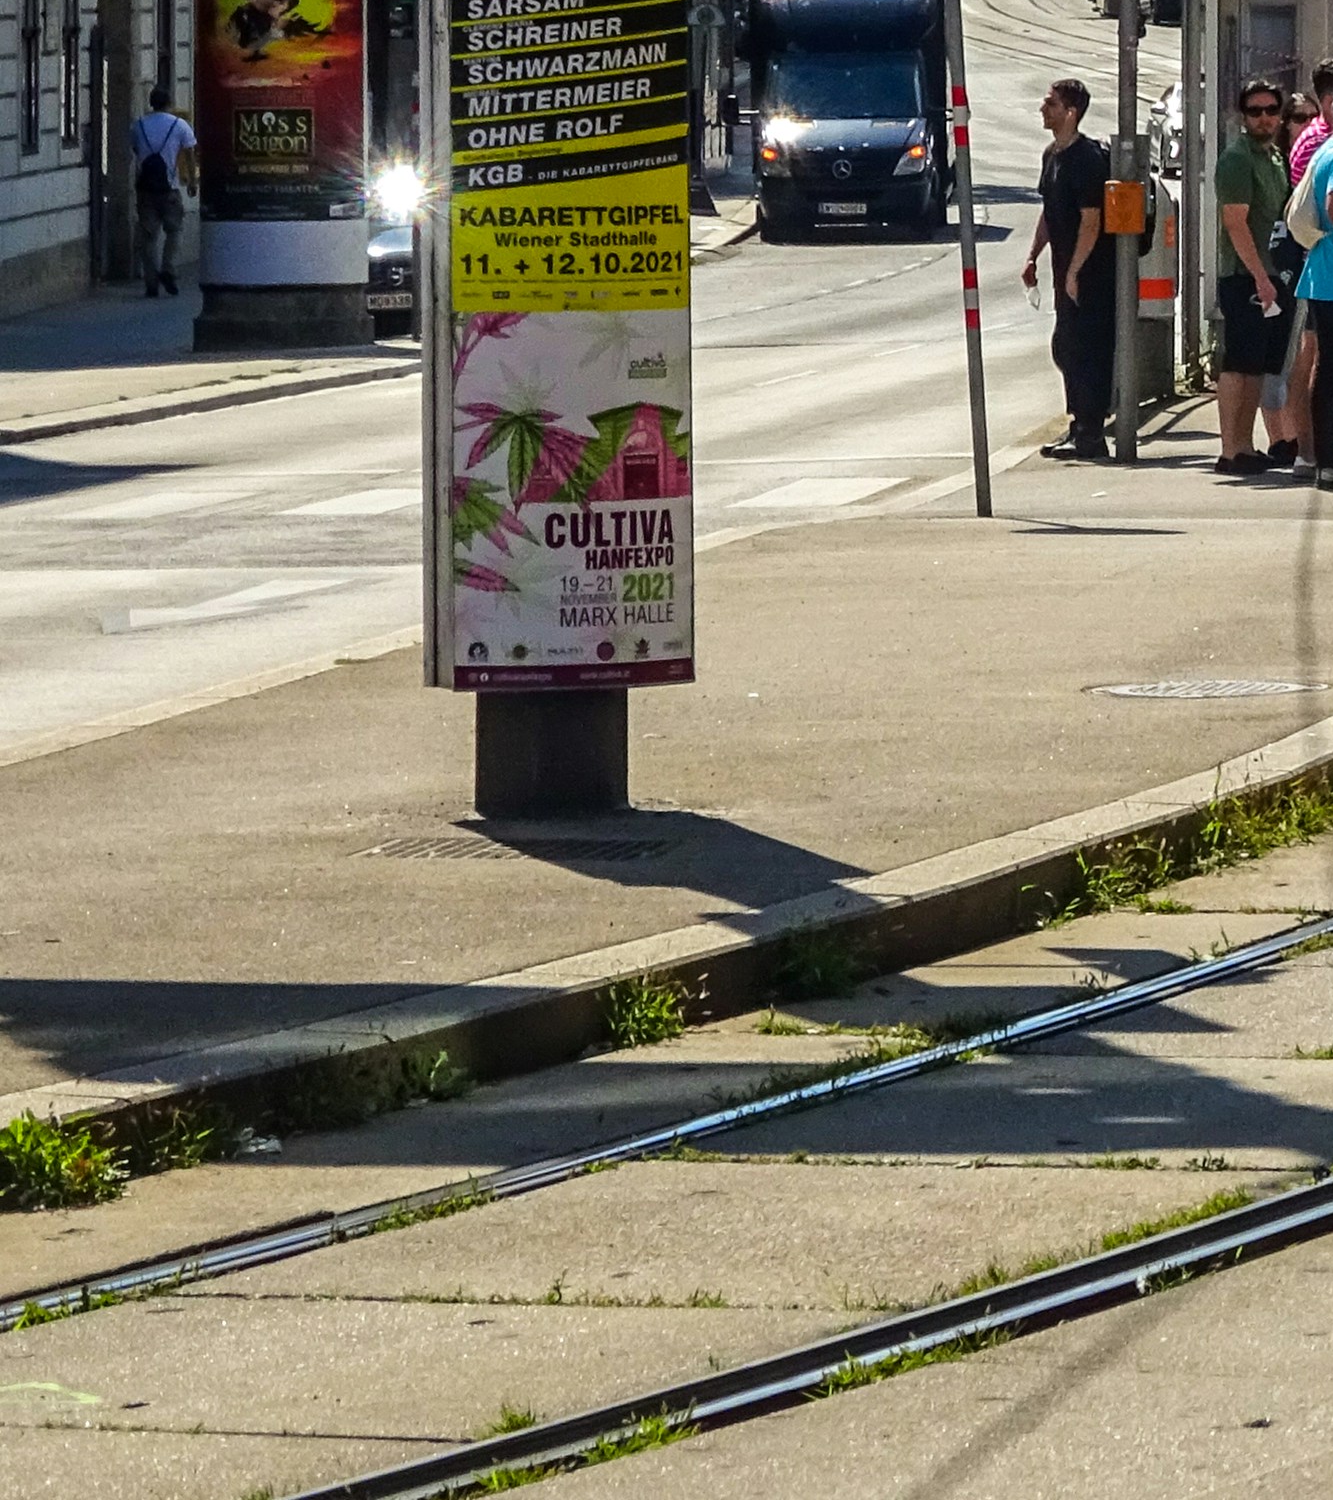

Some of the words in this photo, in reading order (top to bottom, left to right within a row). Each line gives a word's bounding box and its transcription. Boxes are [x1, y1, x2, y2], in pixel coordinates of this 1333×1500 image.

[466, 17, 623, 52] SCHREINER
[467, 42, 668, 85] SCHWARZMANN
[467, 77, 651, 117] MITTERMEIER
[467, 122, 546, 149] OHNE
[555, 113, 625, 141] ROLF
[468, 163, 524, 188] KGB
[538, 170, 559, 181] DIE
[459, 205, 684, 227] KABARETTGIPFEL
[494, 231, 564, 248] Wiener
[569, 231, 657, 248] Stadthalle
[460, 255, 502, 276] 11.
[514, 258, 531, 275] +
[541, 251, 684, 276] 12.10.2021
[544, 508, 674, 549] CULTIVA
[584, 545, 674, 570] HANFEXPO
[622, 572, 675, 603] 2021
[559, 606, 618, 628] MARX
[623, 602, 675, 626] HALLE
